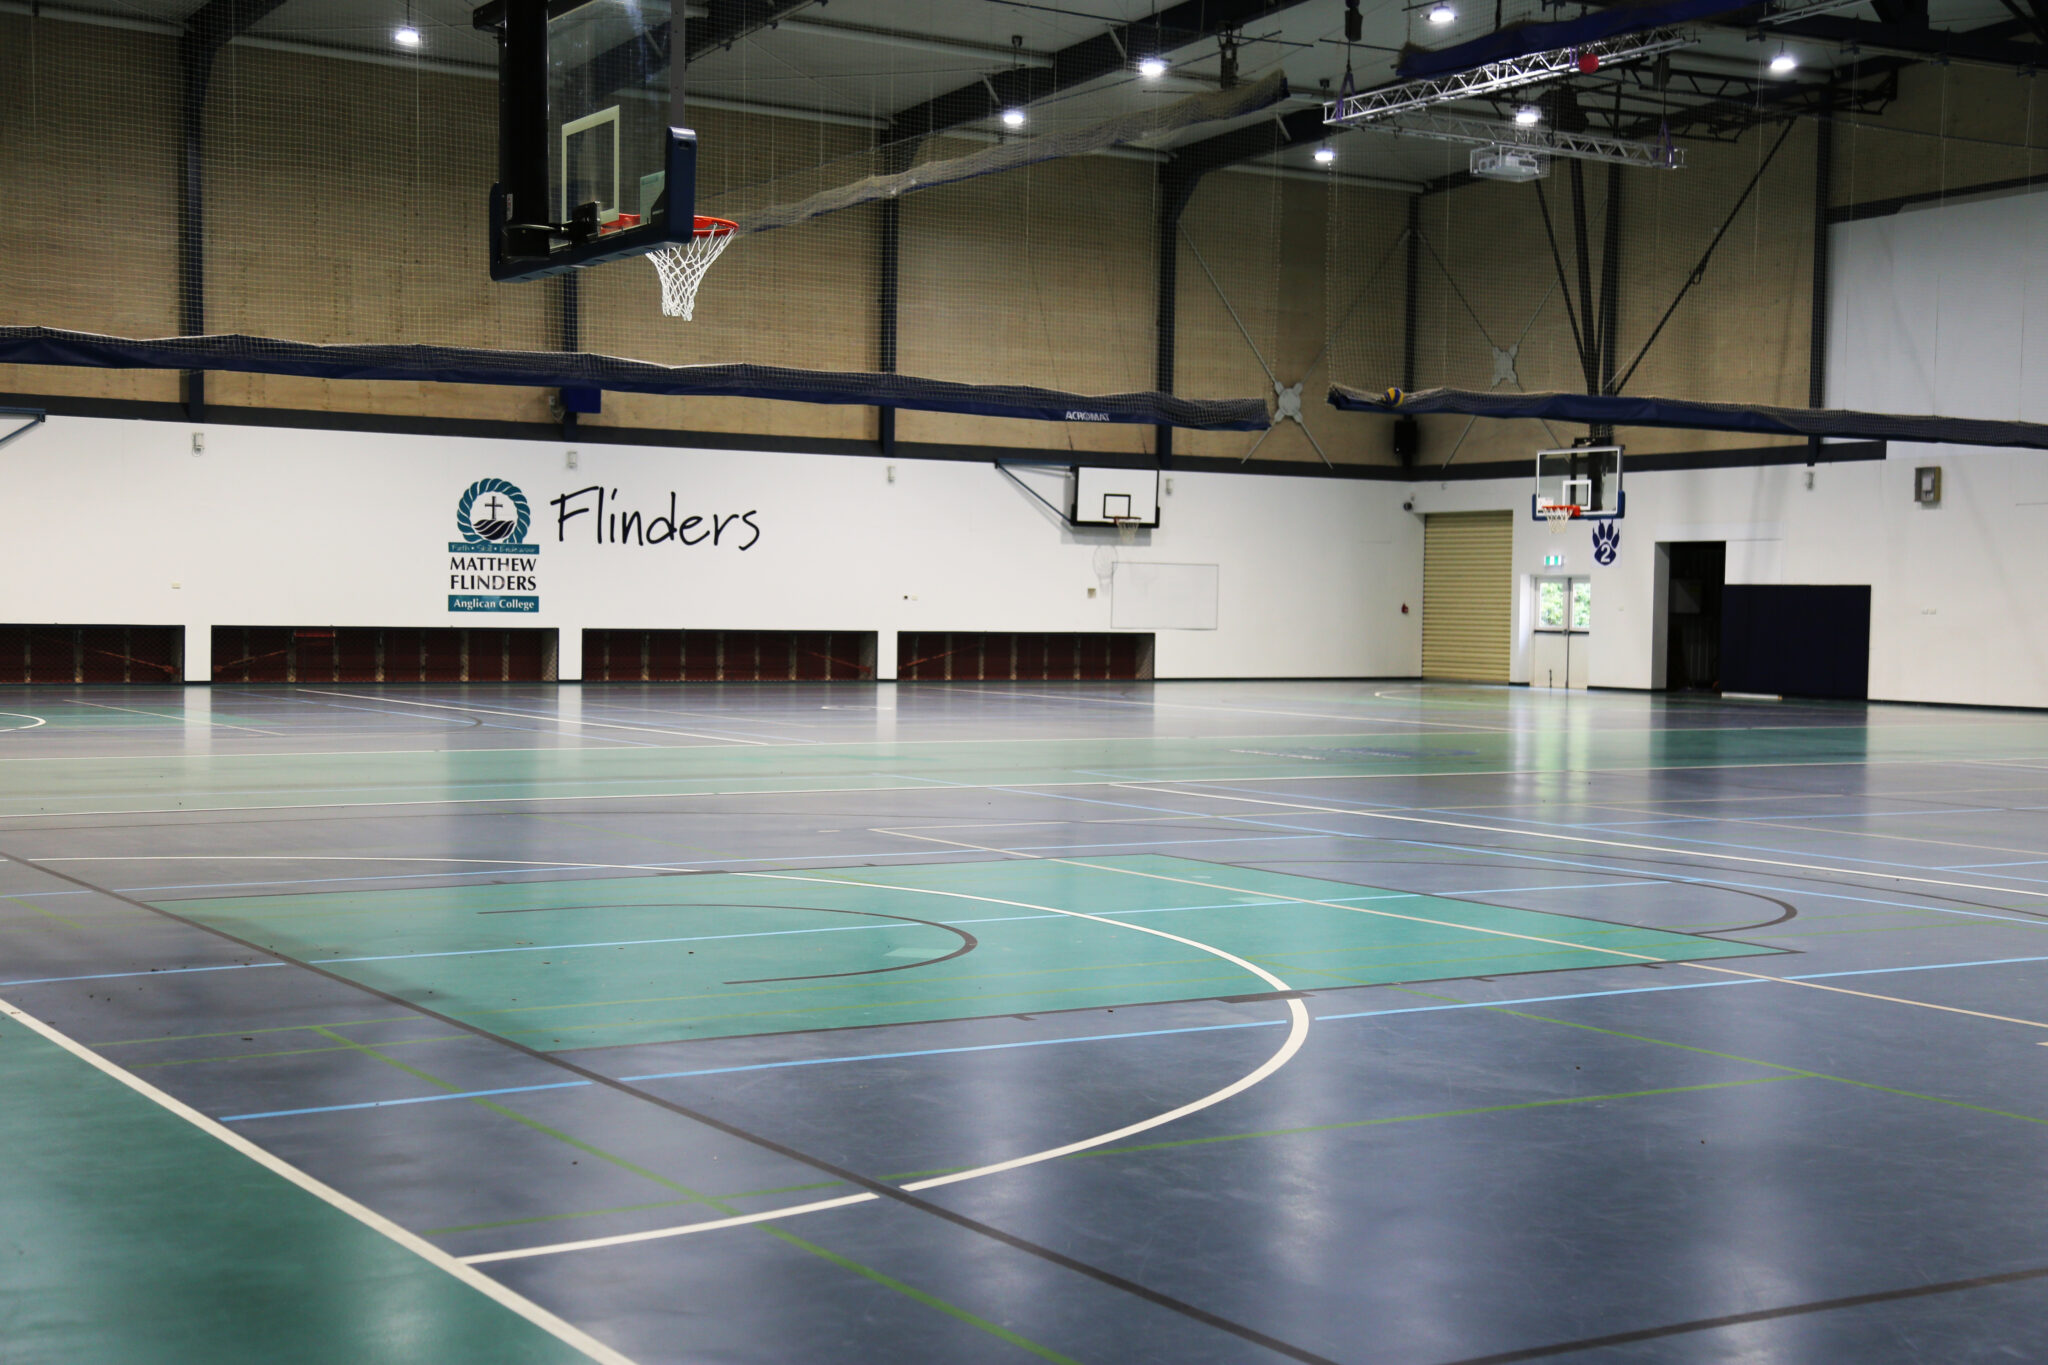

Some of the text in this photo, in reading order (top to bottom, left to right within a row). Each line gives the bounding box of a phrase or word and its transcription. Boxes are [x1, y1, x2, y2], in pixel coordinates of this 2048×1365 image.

[550, 486, 760, 551] Flinders
[1600, 544, 1611, 563] 2
[450, 557, 536, 572] MATTHEW
[450, 575, 536, 591] FLINDERS
[454, 599, 534, 611] Anglican College
